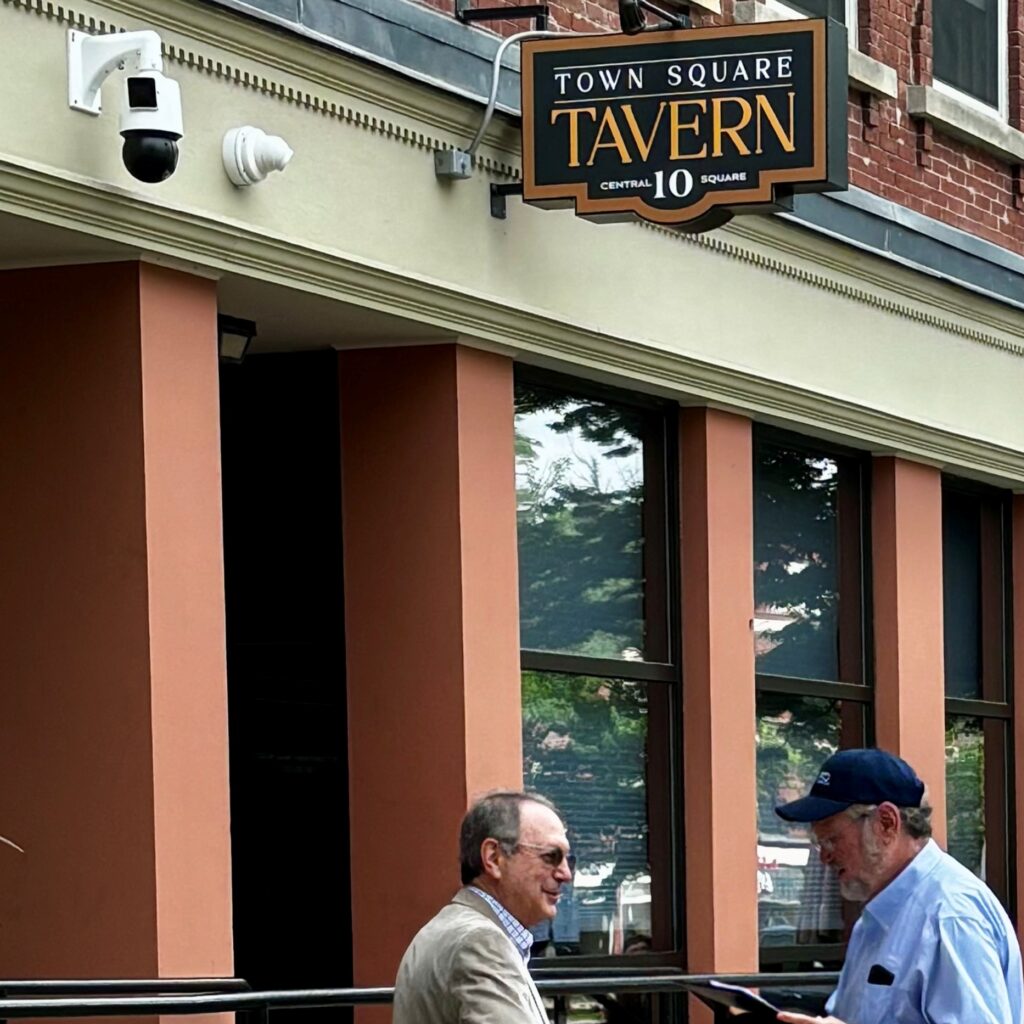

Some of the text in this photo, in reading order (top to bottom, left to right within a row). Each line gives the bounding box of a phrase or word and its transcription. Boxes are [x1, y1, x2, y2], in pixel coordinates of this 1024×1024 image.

[554, 56, 793, 94] TOWN SQUARE
[551, 92, 796, 167] TAVERN
[600, 169, 747, 199] CENTRAL 10 SQUARE
